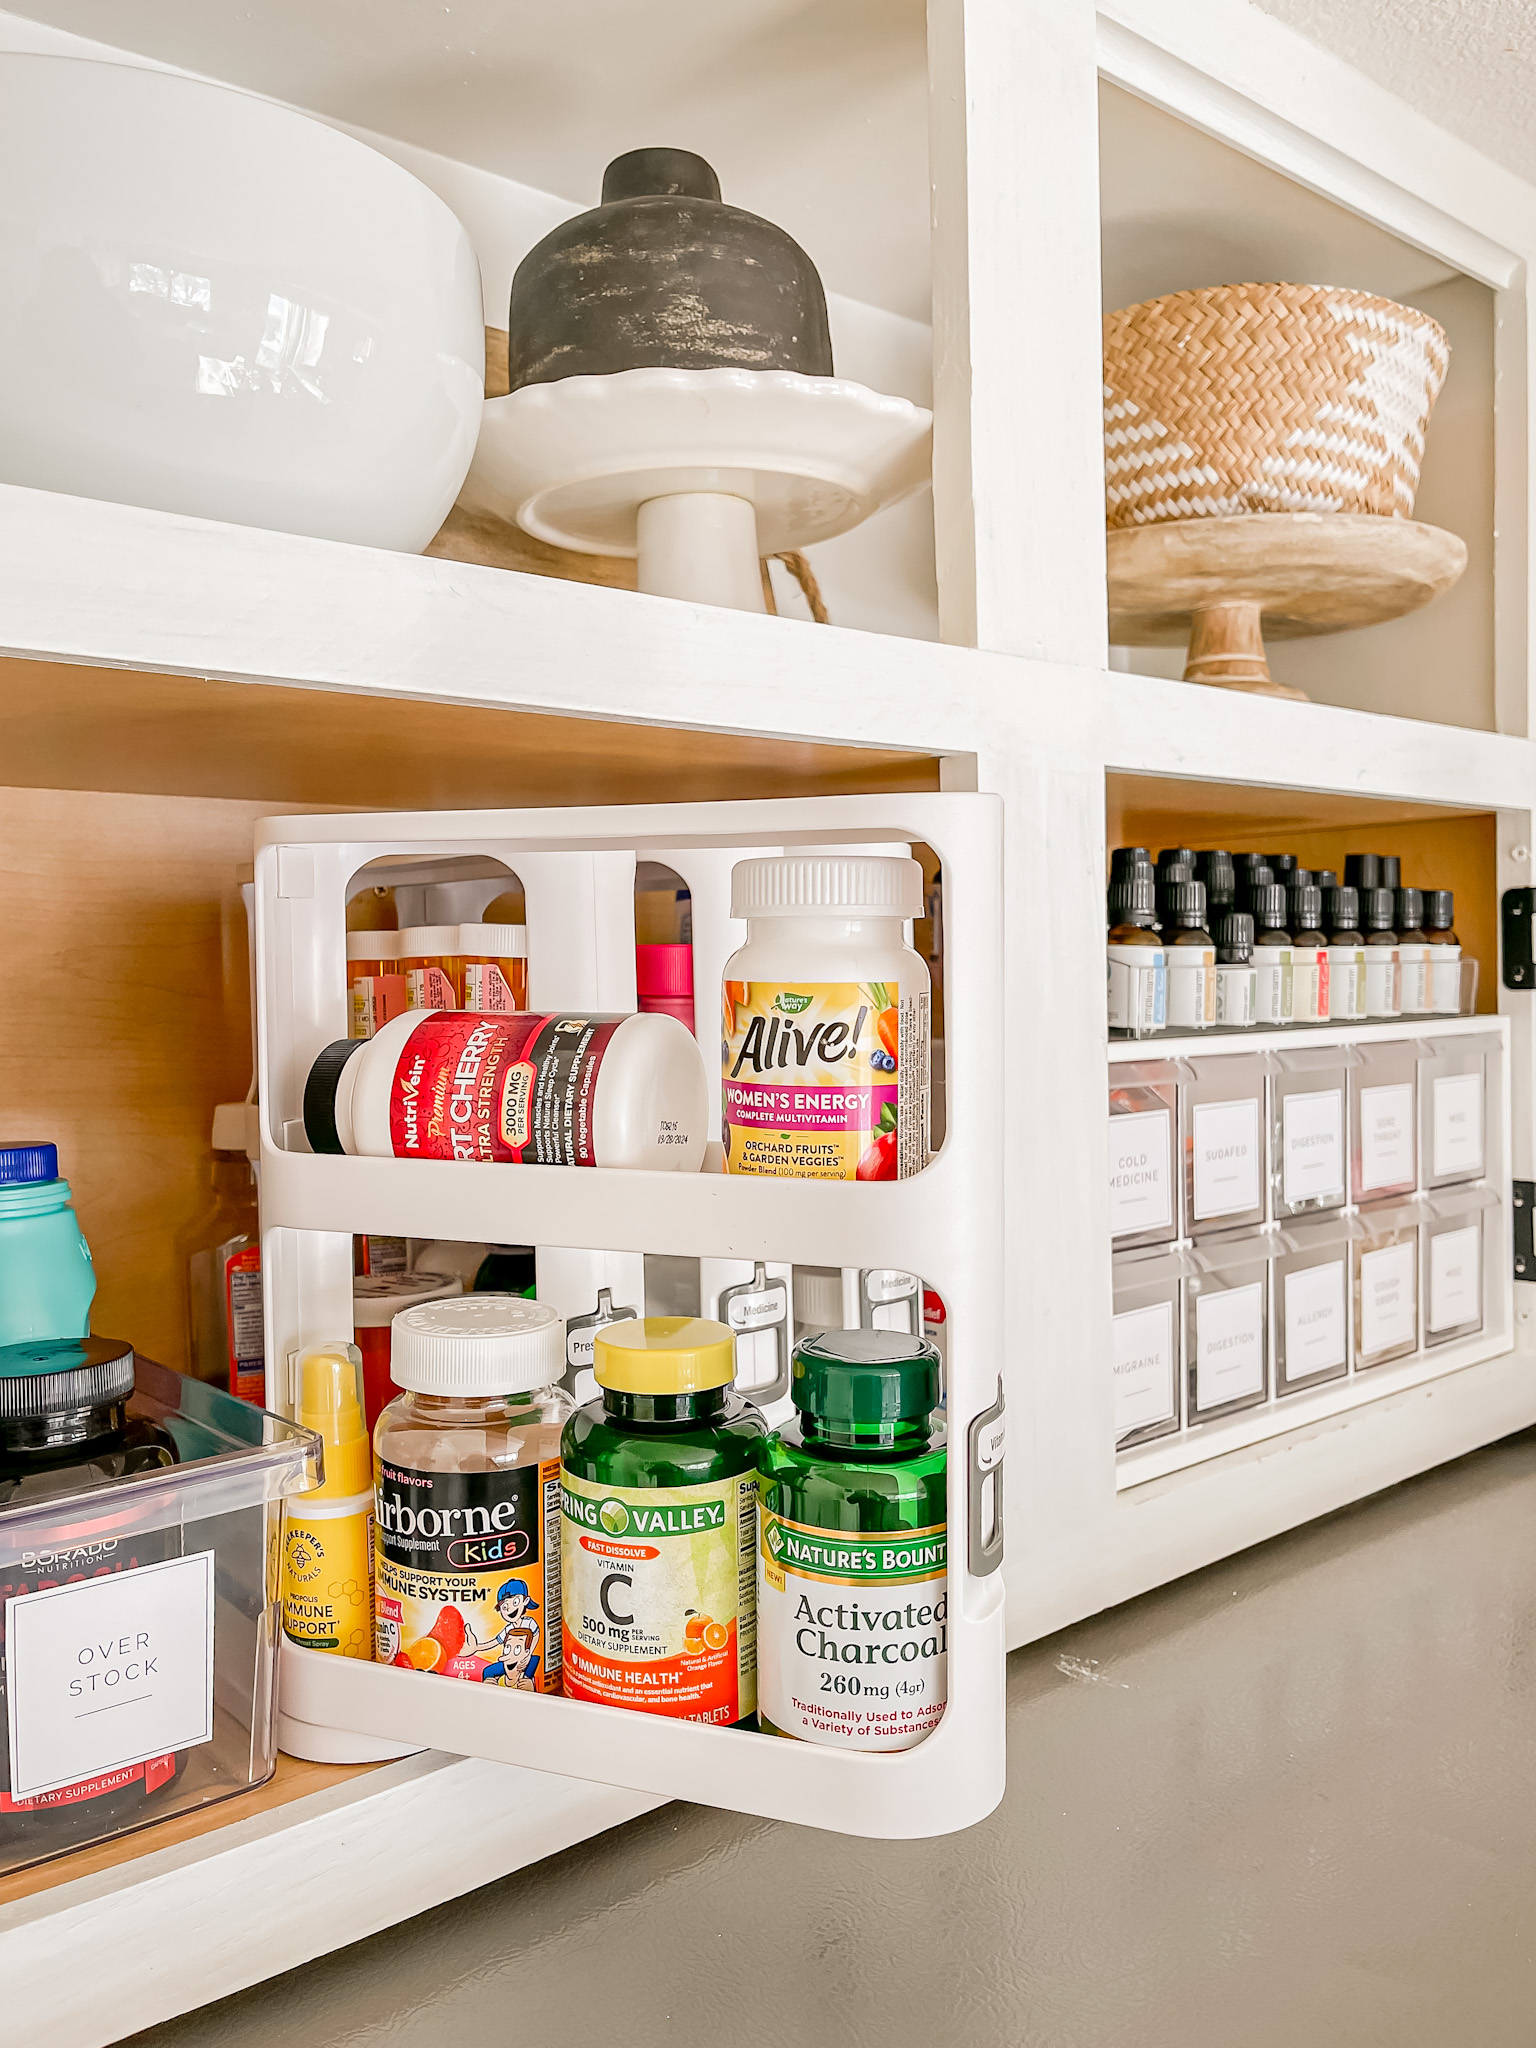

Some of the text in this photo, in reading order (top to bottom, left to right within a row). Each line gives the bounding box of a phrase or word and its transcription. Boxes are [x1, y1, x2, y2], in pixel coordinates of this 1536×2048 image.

[730, 1006, 868, 1079] Alive!
[539, 1053, 553, 1081] Healthy
[568, 1028, 595, 1083] SUPPLEMENT
[451, 1021, 499, 1124] CHERRY
[478, 1037, 508, 1120] STRENGTH
[427, 1060, 451, 1139] Premium
[520, 1075, 529, 1115] SERVING
[545, 1078, 554, 1101] Sleep
[727, 1087, 870, 1110] WOMEN'S ENERGY
[506, 1071, 522, 1136] 3000 MG
[534, 1095, 543, 1129] Muscles
[543, 1102, 551, 1129] Natural
[564, 1084, 575, 1126] DIETARY
[578, 1055, 597, 1159] 90 Vegetable Capsules
[736, 1109, 848, 1124] COMPLETE MULTIVITAMIN
[534, 1129, 545, 1163] Supports
[543, 1130, 554, 1163] Supports
[552, 1130, 563, 1164] Powerful
[745, 1140, 793, 1154] ORCHARD
[1205, 1144, 1247, 1162] SUDAFED
[1291, 1133, 1335, 1150] DIGESTION
[738, 1162, 847, 1180] Powder Blend (100 mg per serving)
[742, 1151, 748, 1162] &
[749, 1152, 790, 1166] GARDEN
[1118, 1154, 1147, 1170] COLD
[880, 1275, 911, 1290] Medicine
[743, 1301, 779, 1317] Medicine
[1206, 1332, 1256, 1354] DIGESTION
[1112, 1353, 1160, 1376] MIGRAINE
[381, 1464, 433, 1489] fruit flavors
[397, 1537, 441, 1553] Supplement
[587, 1541, 646, 1558] FAST DISSOLVE
[787, 1537, 877, 1570] NATURE'S
[37, 1555, 103, 1574] NUTRITION
[379, 1559, 477, 1587] HELPS SUPPORT YOUR
[597, 1559, 635, 1572] VITAMIN
[766, 1568, 783, 1586] NEW!
[290, 1592, 318, 1603] PROPOLIS
[380, 1601, 399, 1618] Blend
[599, 1573, 634, 1626] C
[794, 1592, 947, 1631] Activated
[582, 1615, 606, 1635] 500
[608, 1627, 630, 1643] mg
[78, 1632, 150, 1665] OVER
[312, 1640, 330, 1648] Spray
[577, 1630, 668, 1655] DIETARY SUPPLEMENT
[796, 1625, 947, 1664] Charcoal
[453, 1660, 476, 1670] AGES
[578, 1657, 622, 1682] IMMUNE
[680, 1658, 701, 1667] Natural
[707, 1650, 729, 1662] Artificial
[687, 1659, 724, 1672] Orange Flavor
[69, 1657, 158, 1697] STOCK
[622, 1686, 634, 1695] and
[644, 1686, 673, 1696] essential
[674, 1684, 700, 1695] nutrient
[700, 1681, 713, 1690] that
[819, 1672, 925, 1700] 260 mg (4gr)
[602, 1691, 647, 1704] cardiovascular,
[647, 1695, 660, 1703] and
[661, 1694, 678, 1703] bone
[791, 1697, 863, 1723] Traditionally
[866, 1710, 897, 1722] Used
[901, 1710, 913, 1720] to
[802, 1716, 808, 1725] a
[813, 1719, 854, 1736] Variety
[857, 1725, 871, 1736] of
[17, 1768, 134, 1807] DIETARY SUPPLEMENT
